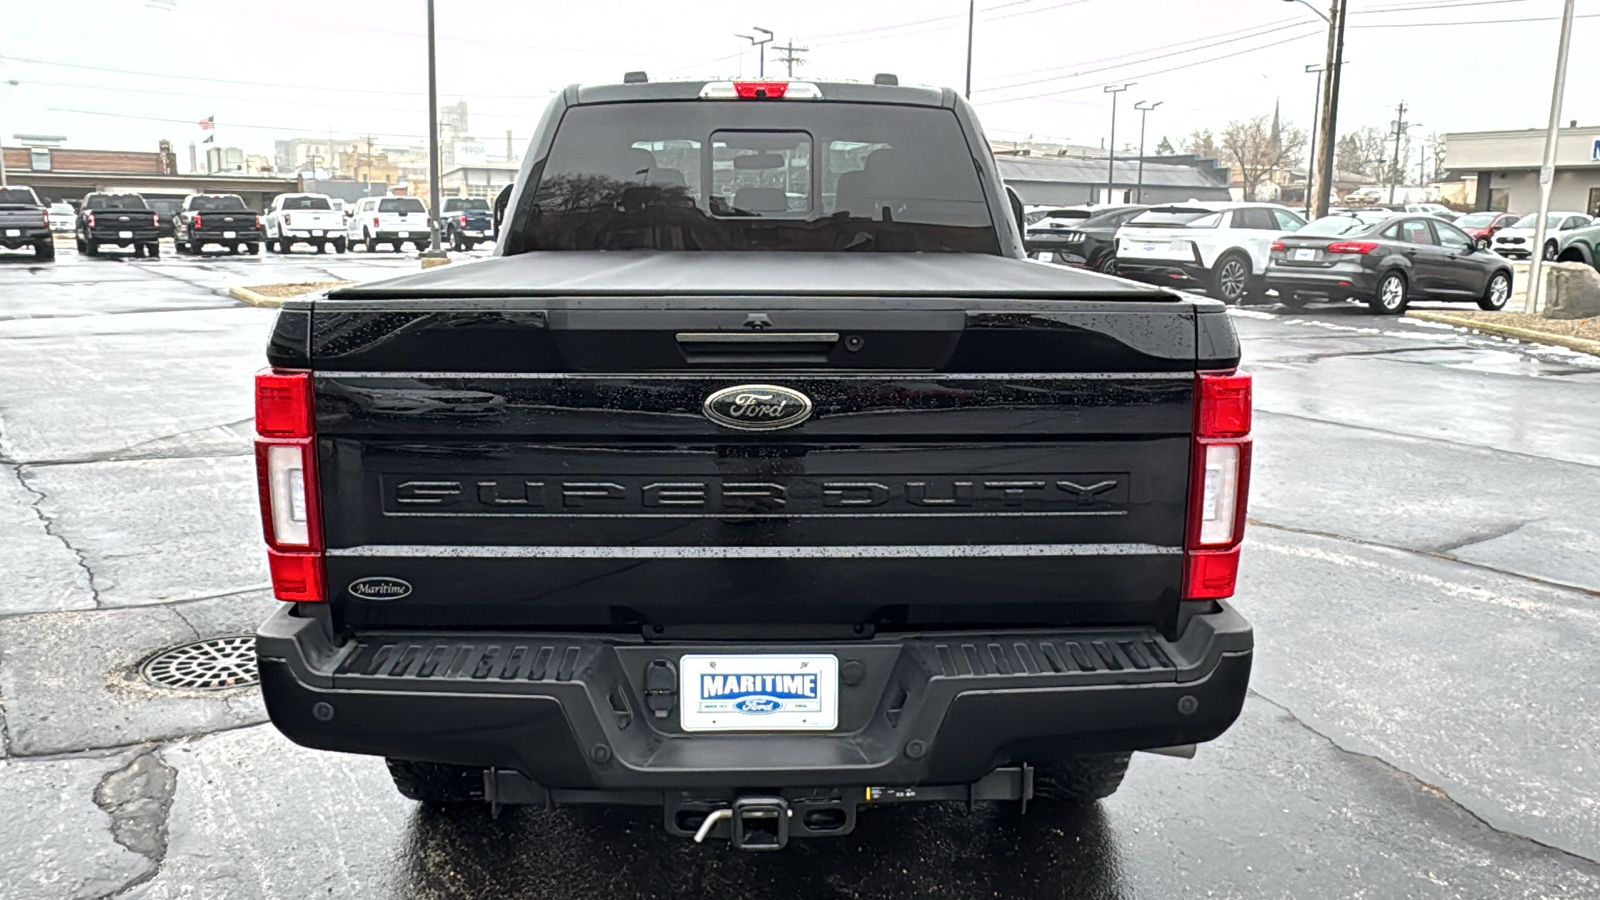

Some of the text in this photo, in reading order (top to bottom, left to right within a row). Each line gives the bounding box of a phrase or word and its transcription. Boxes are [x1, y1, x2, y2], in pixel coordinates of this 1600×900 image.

[729, 393, 787, 417] Ford
[396, 480, 1119, 508] SUPER DUTY
[356, 582, 406, 594] Maritime
[702, 675, 816, 698] MARITIME
[742, 699, 774, 712] Ford
